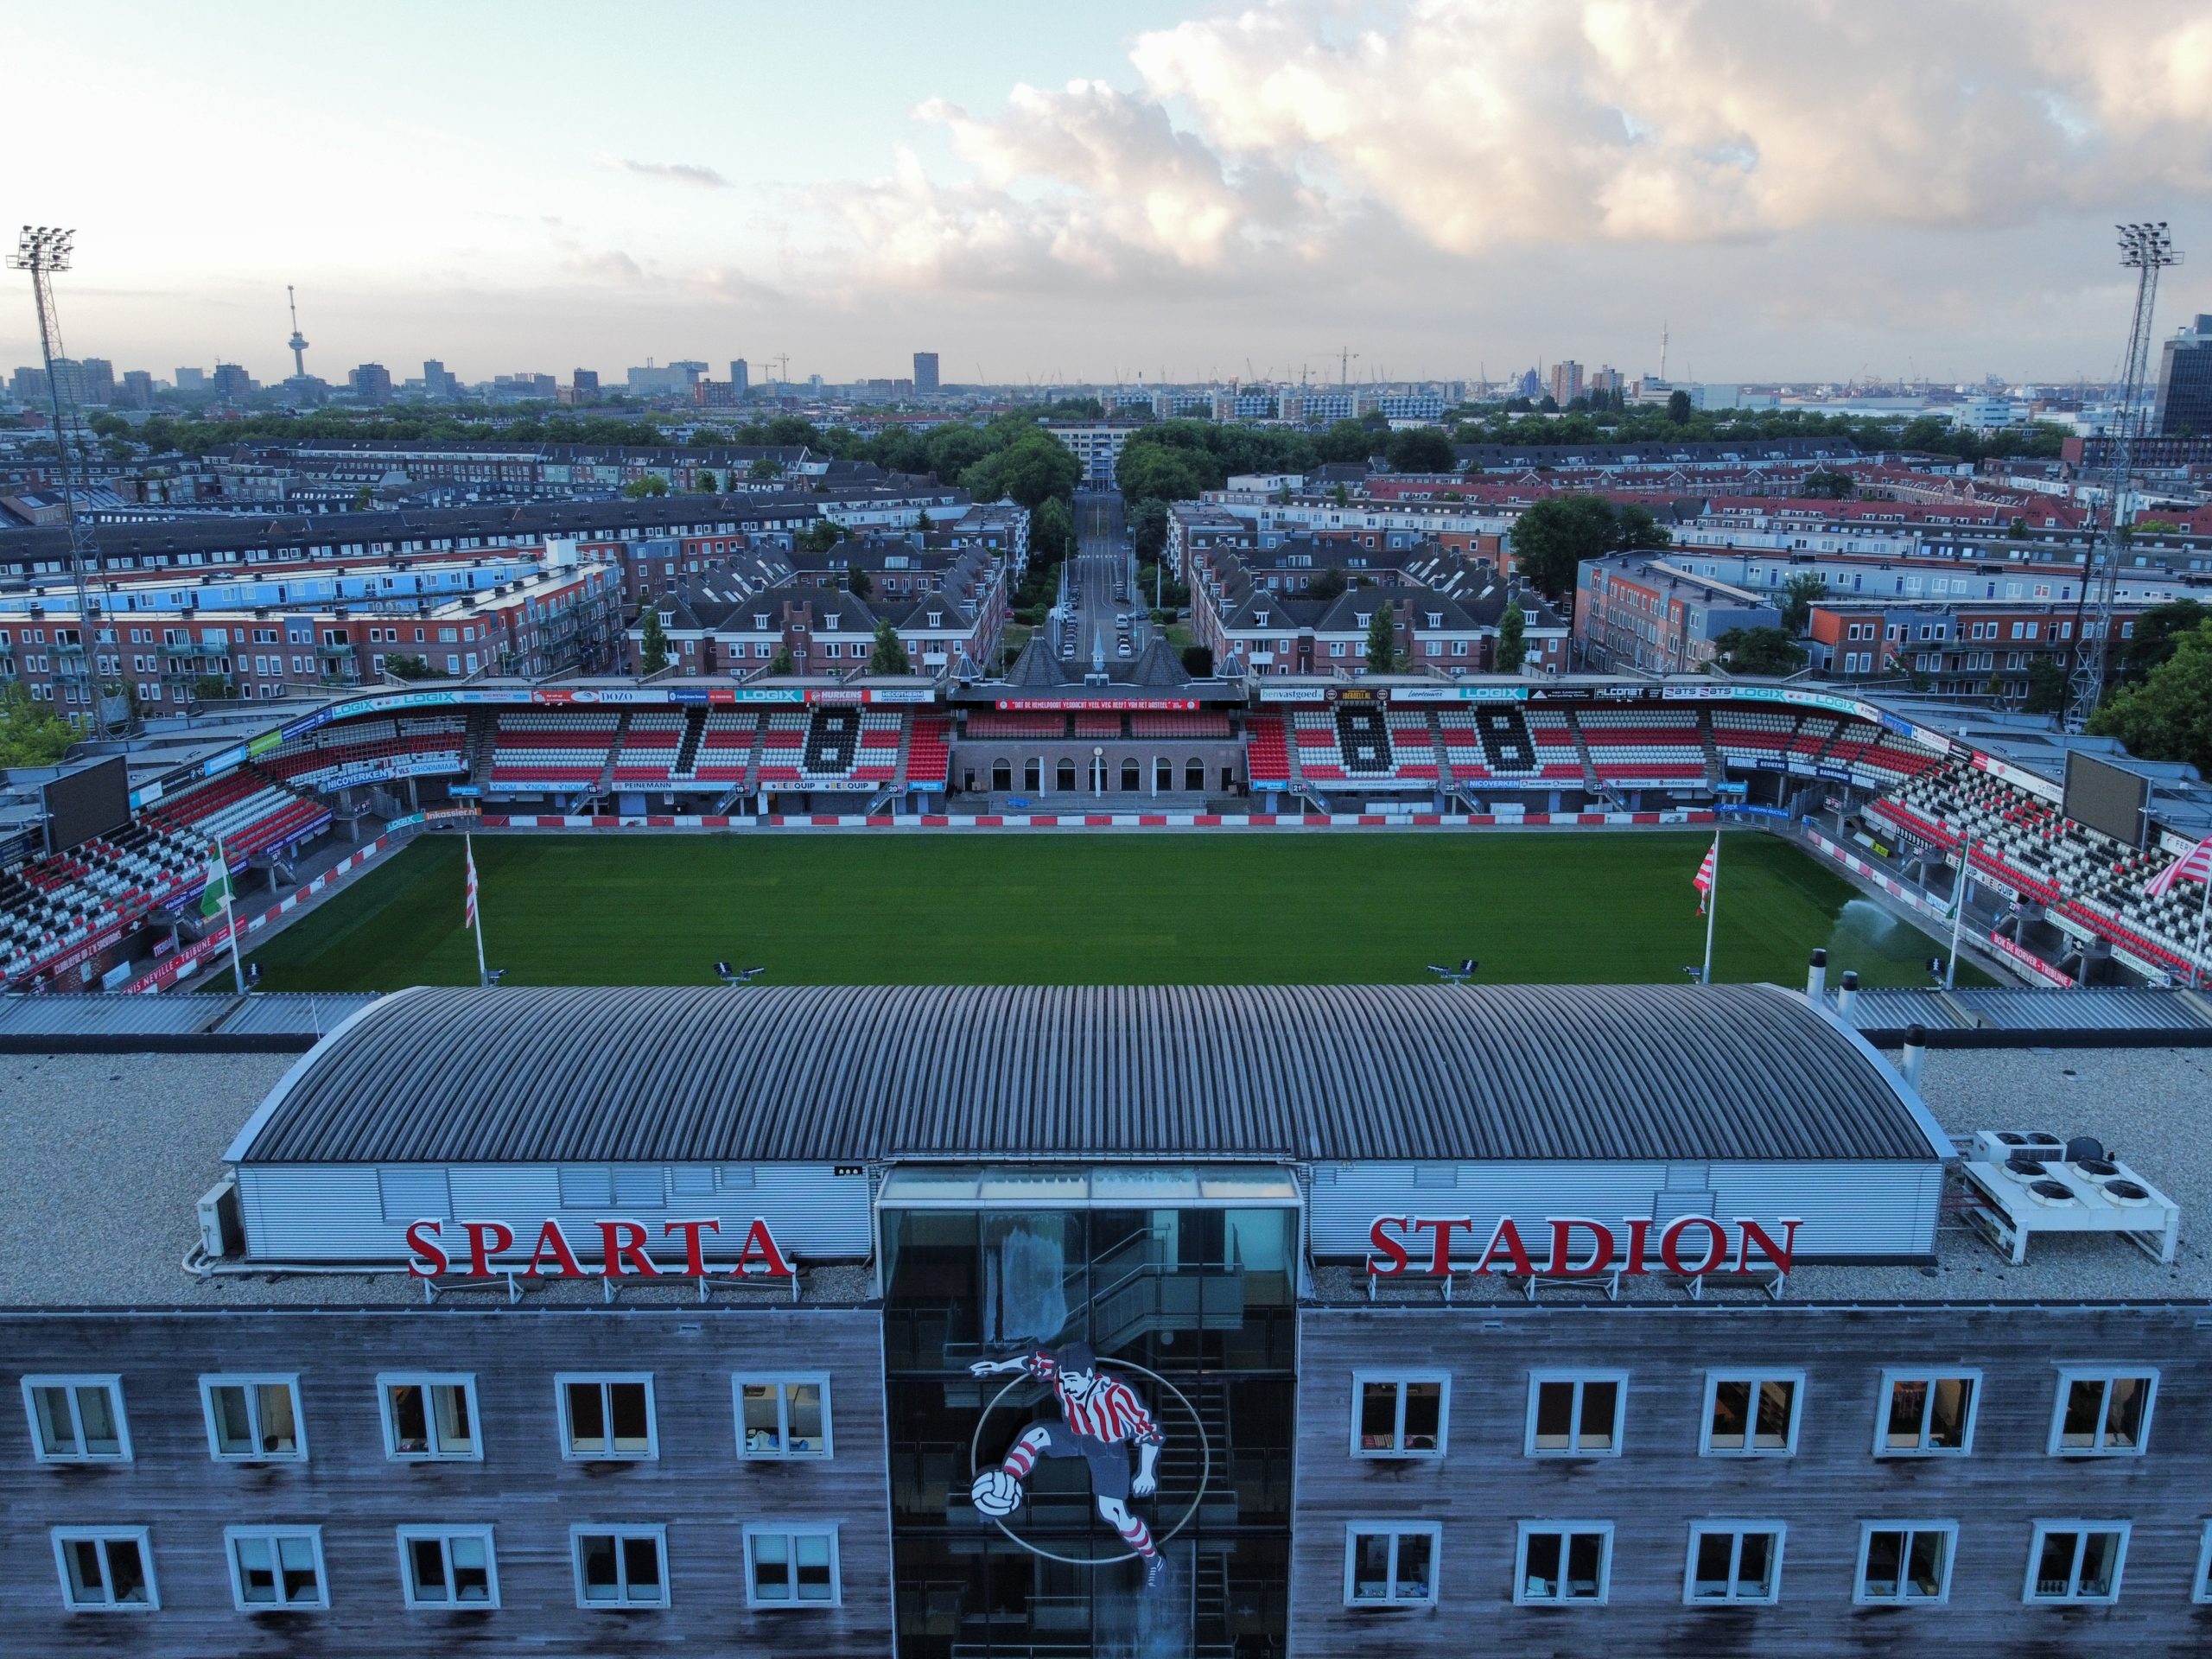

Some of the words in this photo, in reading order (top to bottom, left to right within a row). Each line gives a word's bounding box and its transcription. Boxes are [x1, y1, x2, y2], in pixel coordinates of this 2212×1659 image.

[404, 693, 455, 704] LOGIX
[601, 692, 633, 701] DOZO
[743, 690, 798, 701] LOGIX
[1262, 690, 1318, 700] benvastgoed
[1465, 689, 1518, 698] LOGIX
[1735, 688, 1784, 700] LOGIX
[334, 700, 375, 716] LOGIX
[1816, 695, 1856, 714] LOGIX
[411, 762, 459, 773] SCHOONMAAK
[1727, 757, 1758, 768] WOONING
[1789, 762, 1817, 776] WOONING
[327, 769, 390, 790] NICOVERKEN
[387, 816, 415, 830] LOGIX
[143, 961, 173, 987] NEVILLE
[181, 938, 211, 963] TRIBUNE
[1994, 932, 2006, 949] BOK
[2006, 940, 2015, 954] DE
[2015, 945, 2037, 966] KORVER
[2041, 962, 2069, 987] TRIBUNE
[406, 1217, 797, 1278] SPARTA
[1367, 1214, 1803, 1276] STADION
